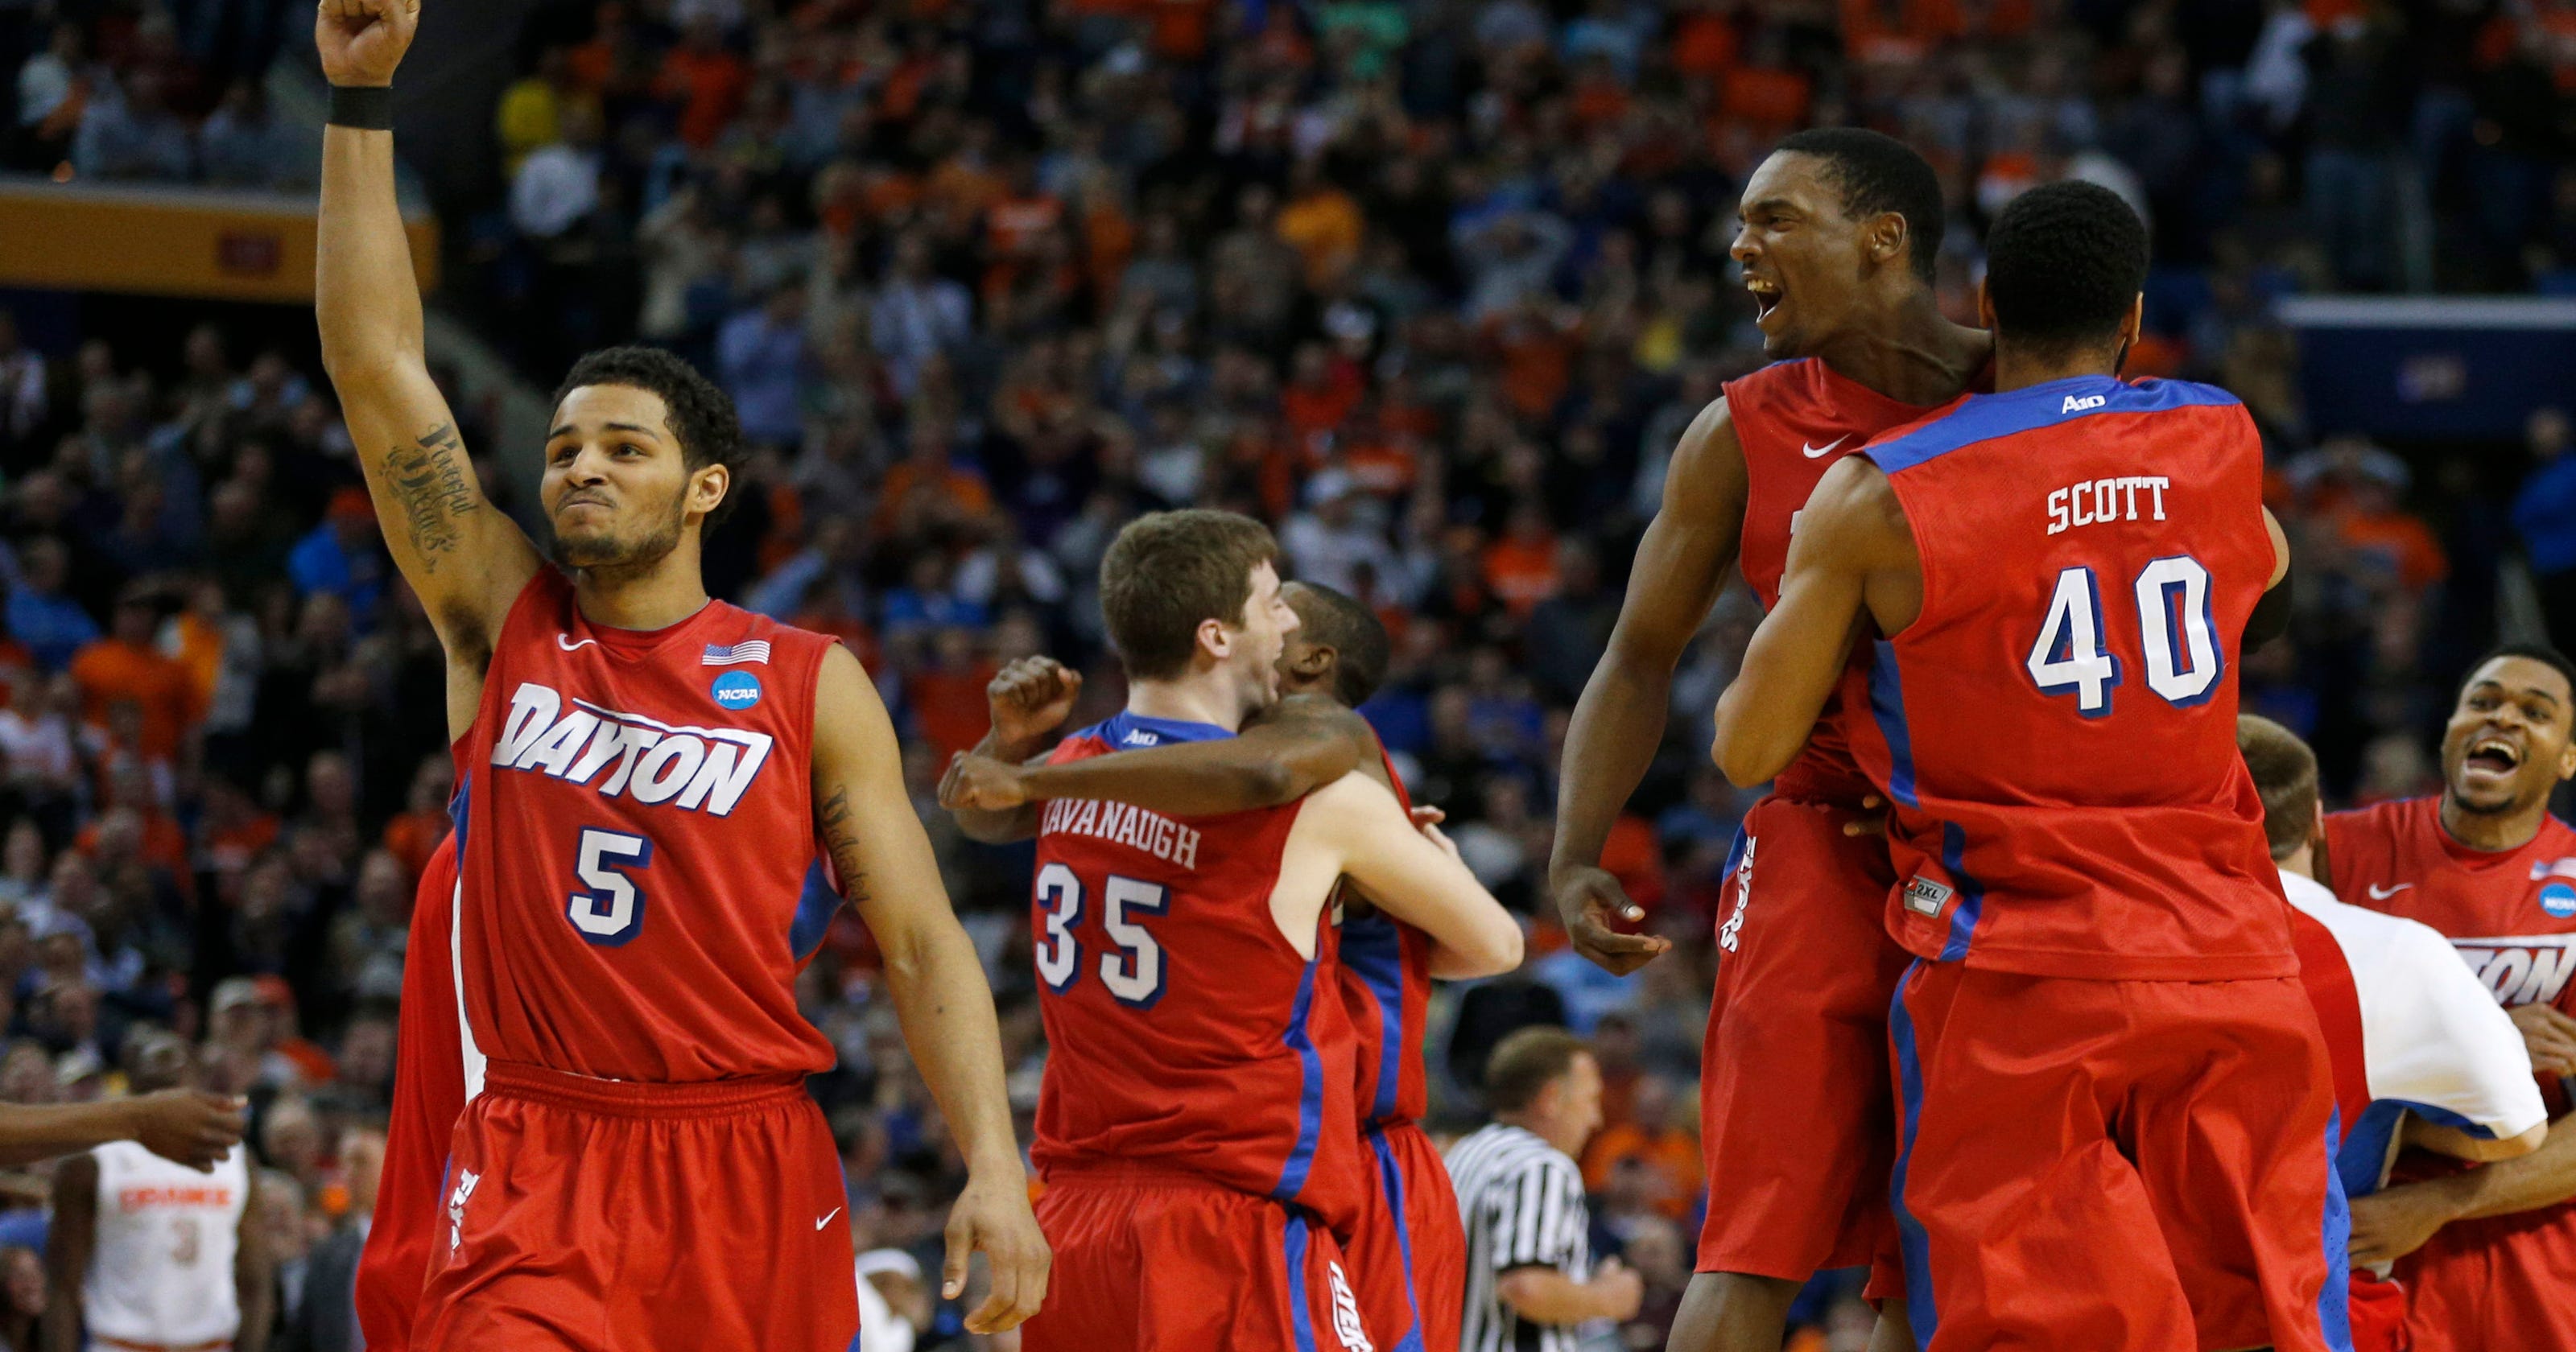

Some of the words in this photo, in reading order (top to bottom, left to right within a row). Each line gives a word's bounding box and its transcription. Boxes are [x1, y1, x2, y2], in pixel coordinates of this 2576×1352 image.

[2047, 476, 2169, 536] SCOTT
[718, 688, 758, 700] NCAA
[2027, 555, 2225, 718] 40
[489, 682, 773, 818] DAYTON
[567, 824, 654, 948] 5
[1036, 862, 1170, 1011] 35
[1719, 836, 1757, 953] FLYERS
[1917, 884, 1938, 900] 2XL
[171, 1217, 200, 1269] 3
